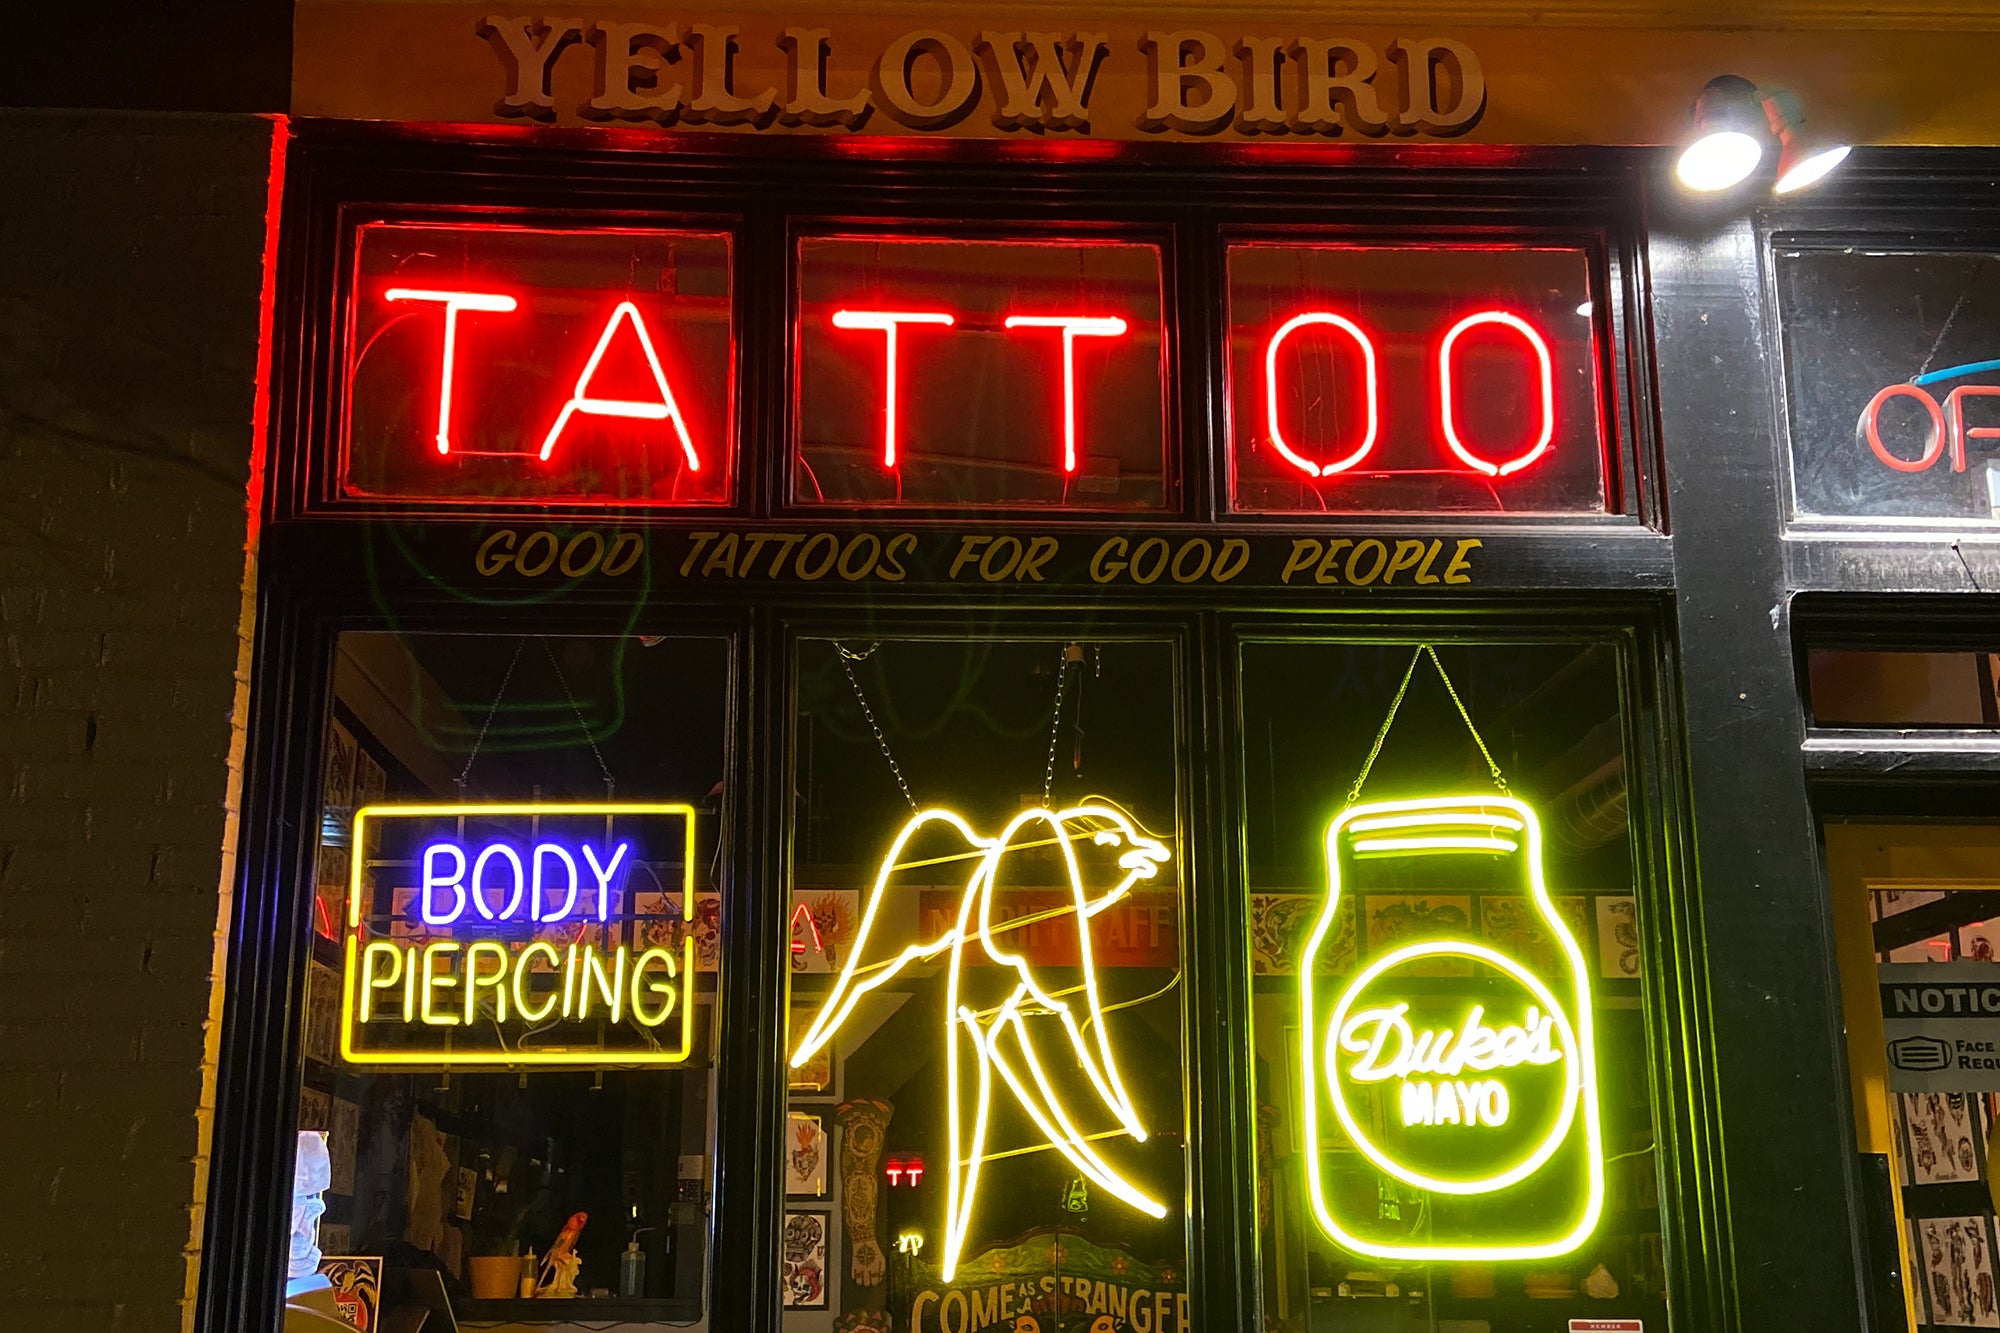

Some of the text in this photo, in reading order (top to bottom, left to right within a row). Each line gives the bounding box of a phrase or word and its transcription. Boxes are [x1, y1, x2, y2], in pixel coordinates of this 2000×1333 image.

[478, 15, 1487, 138] YELLOW BIRD
[383, 287, 1555, 477] TATTOO
[475, 529, 1483, 586] GOOD TATTOOS FOR GOOD PEOPLE
[422, 843, 627, 925] BODY
[360, 942, 677, 1027] PIERCING
[1340, 1002, 1563, 1081] Duke's
[1401, 1080, 1510, 1127] MAYO
[911, 1283, 1017, 1333] COME
